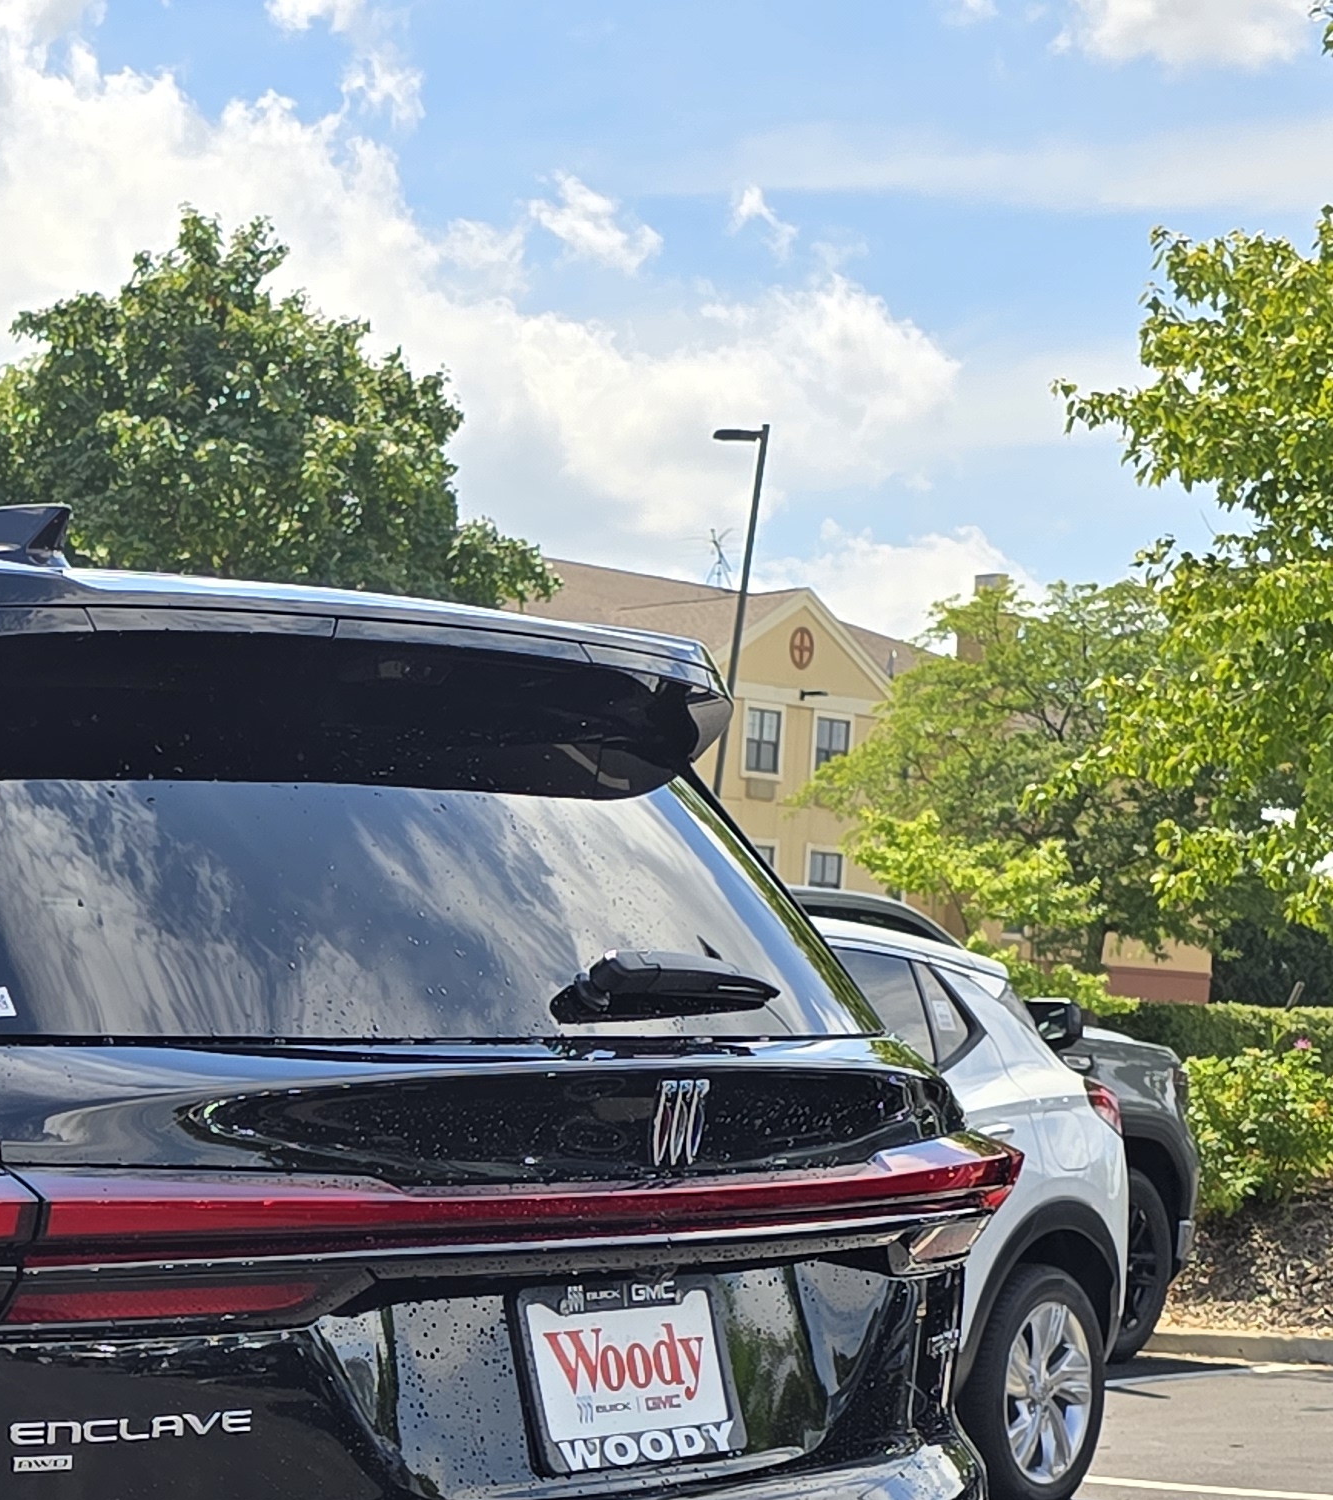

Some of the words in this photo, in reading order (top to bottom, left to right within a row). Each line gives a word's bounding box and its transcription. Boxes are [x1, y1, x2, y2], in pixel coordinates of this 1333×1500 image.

[631, 1280, 675, 1301] GMC
[543, 1323, 704, 1401] Woody
[645, 1394, 682, 1411] GMC
[10, 1409, 253, 1445] ENCLAVE
[558, 1420, 734, 1472] WOODY
